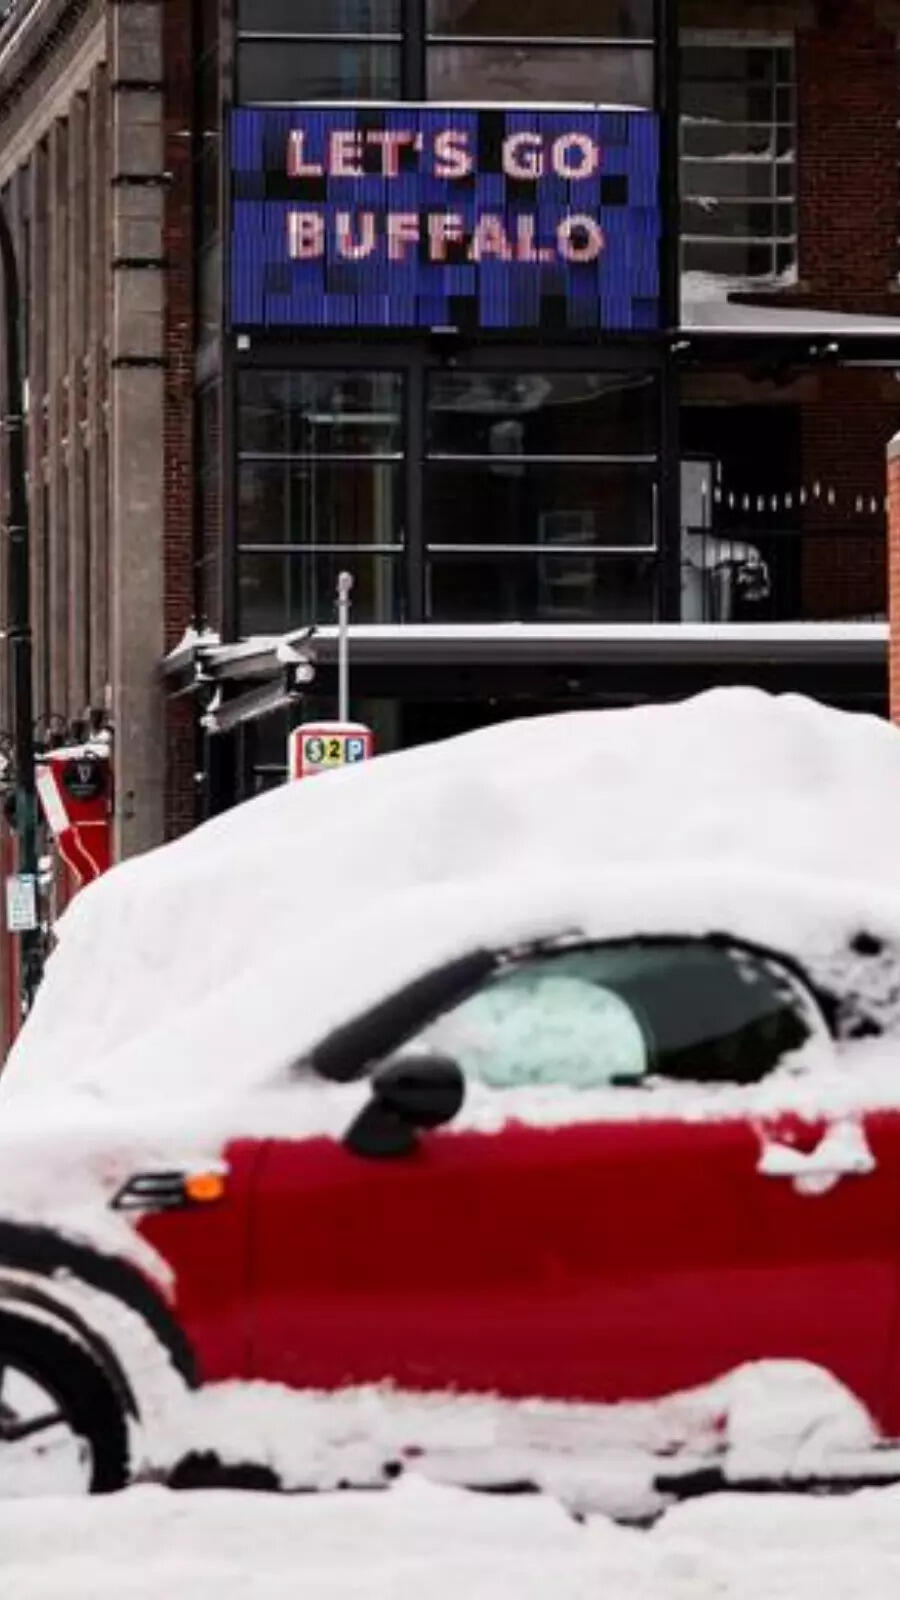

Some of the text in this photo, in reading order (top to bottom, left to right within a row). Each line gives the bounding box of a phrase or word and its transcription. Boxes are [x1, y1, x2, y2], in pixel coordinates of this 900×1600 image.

[287, 130, 600, 178] LET'S GO
[286, 211, 605, 262] BUFFALO
